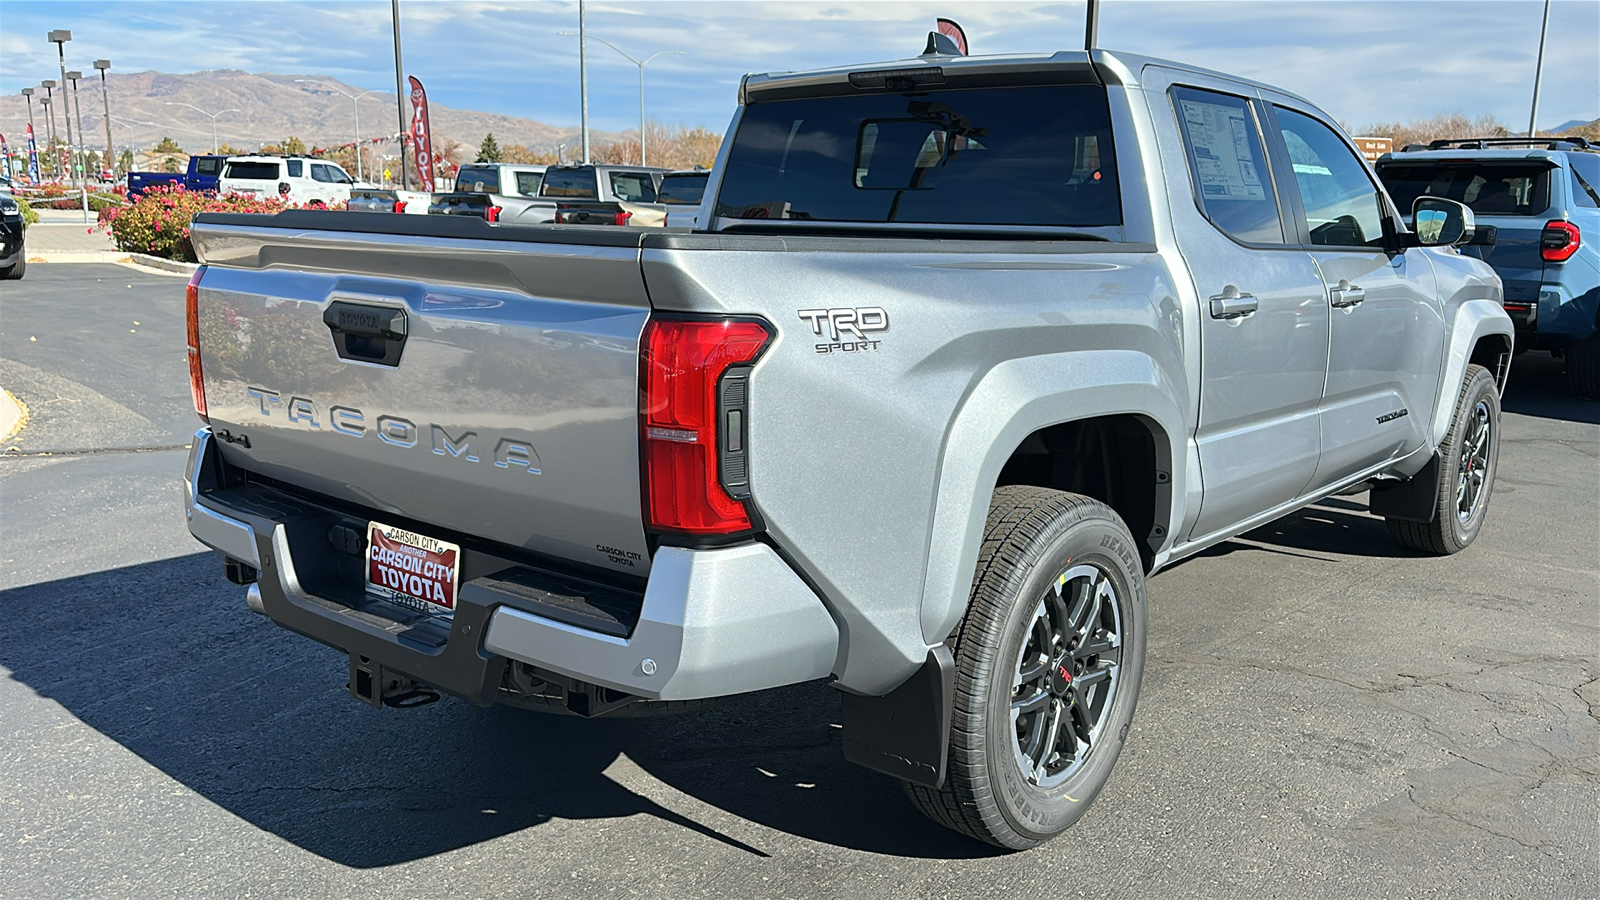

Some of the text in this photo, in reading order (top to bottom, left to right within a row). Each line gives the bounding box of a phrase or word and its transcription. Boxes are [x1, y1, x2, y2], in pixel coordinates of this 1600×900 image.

[415, 105, 433, 192] TOYOTA
[340, 312, 379, 330] TOYOTA
[797, 306, 889, 342] TRD
[815, 340, 882, 355] SPORT
[247, 386, 542, 475] TACOMA
[390, 527, 439, 552] CARSON CITY
[398, 544, 427, 559] ANOTHER
[370, 545, 454, 583] CARSON CITY
[596, 544, 642, 561] CARSON CITY
[607, 554, 636, 568] TOYOTA
[1099, 533, 1141, 602] GENERAL
[377, 564, 447, 604] TOYOTA
[389, 590, 430, 613] TOYOTA
